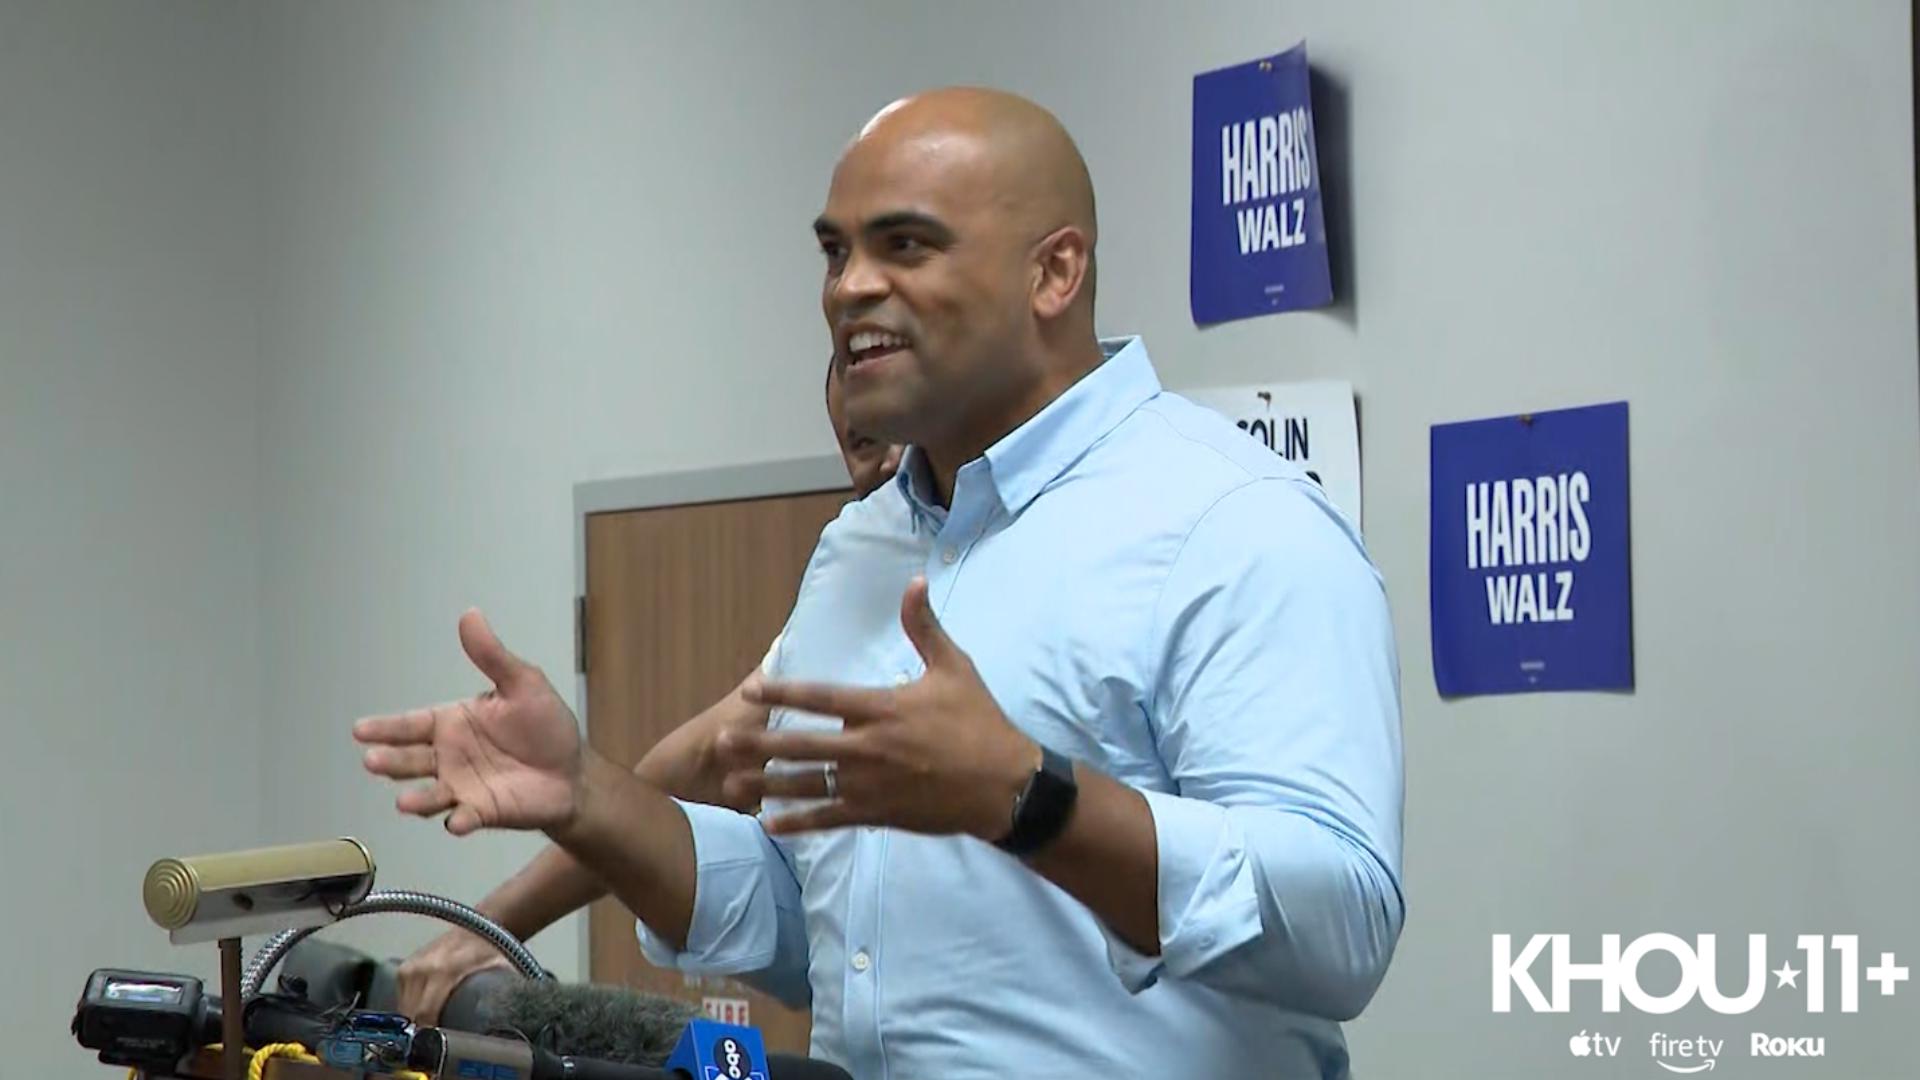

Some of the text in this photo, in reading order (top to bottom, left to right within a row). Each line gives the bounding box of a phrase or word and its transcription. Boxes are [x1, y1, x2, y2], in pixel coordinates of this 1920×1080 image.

[1221, 106, 1311, 206] HARRIS
[1237, 198, 1306, 255] WALZ
[1237, 417, 1310, 462] OLIN
[1466, 471, 1592, 570] HARRIS
[1485, 570, 1574, 625] WALZ
